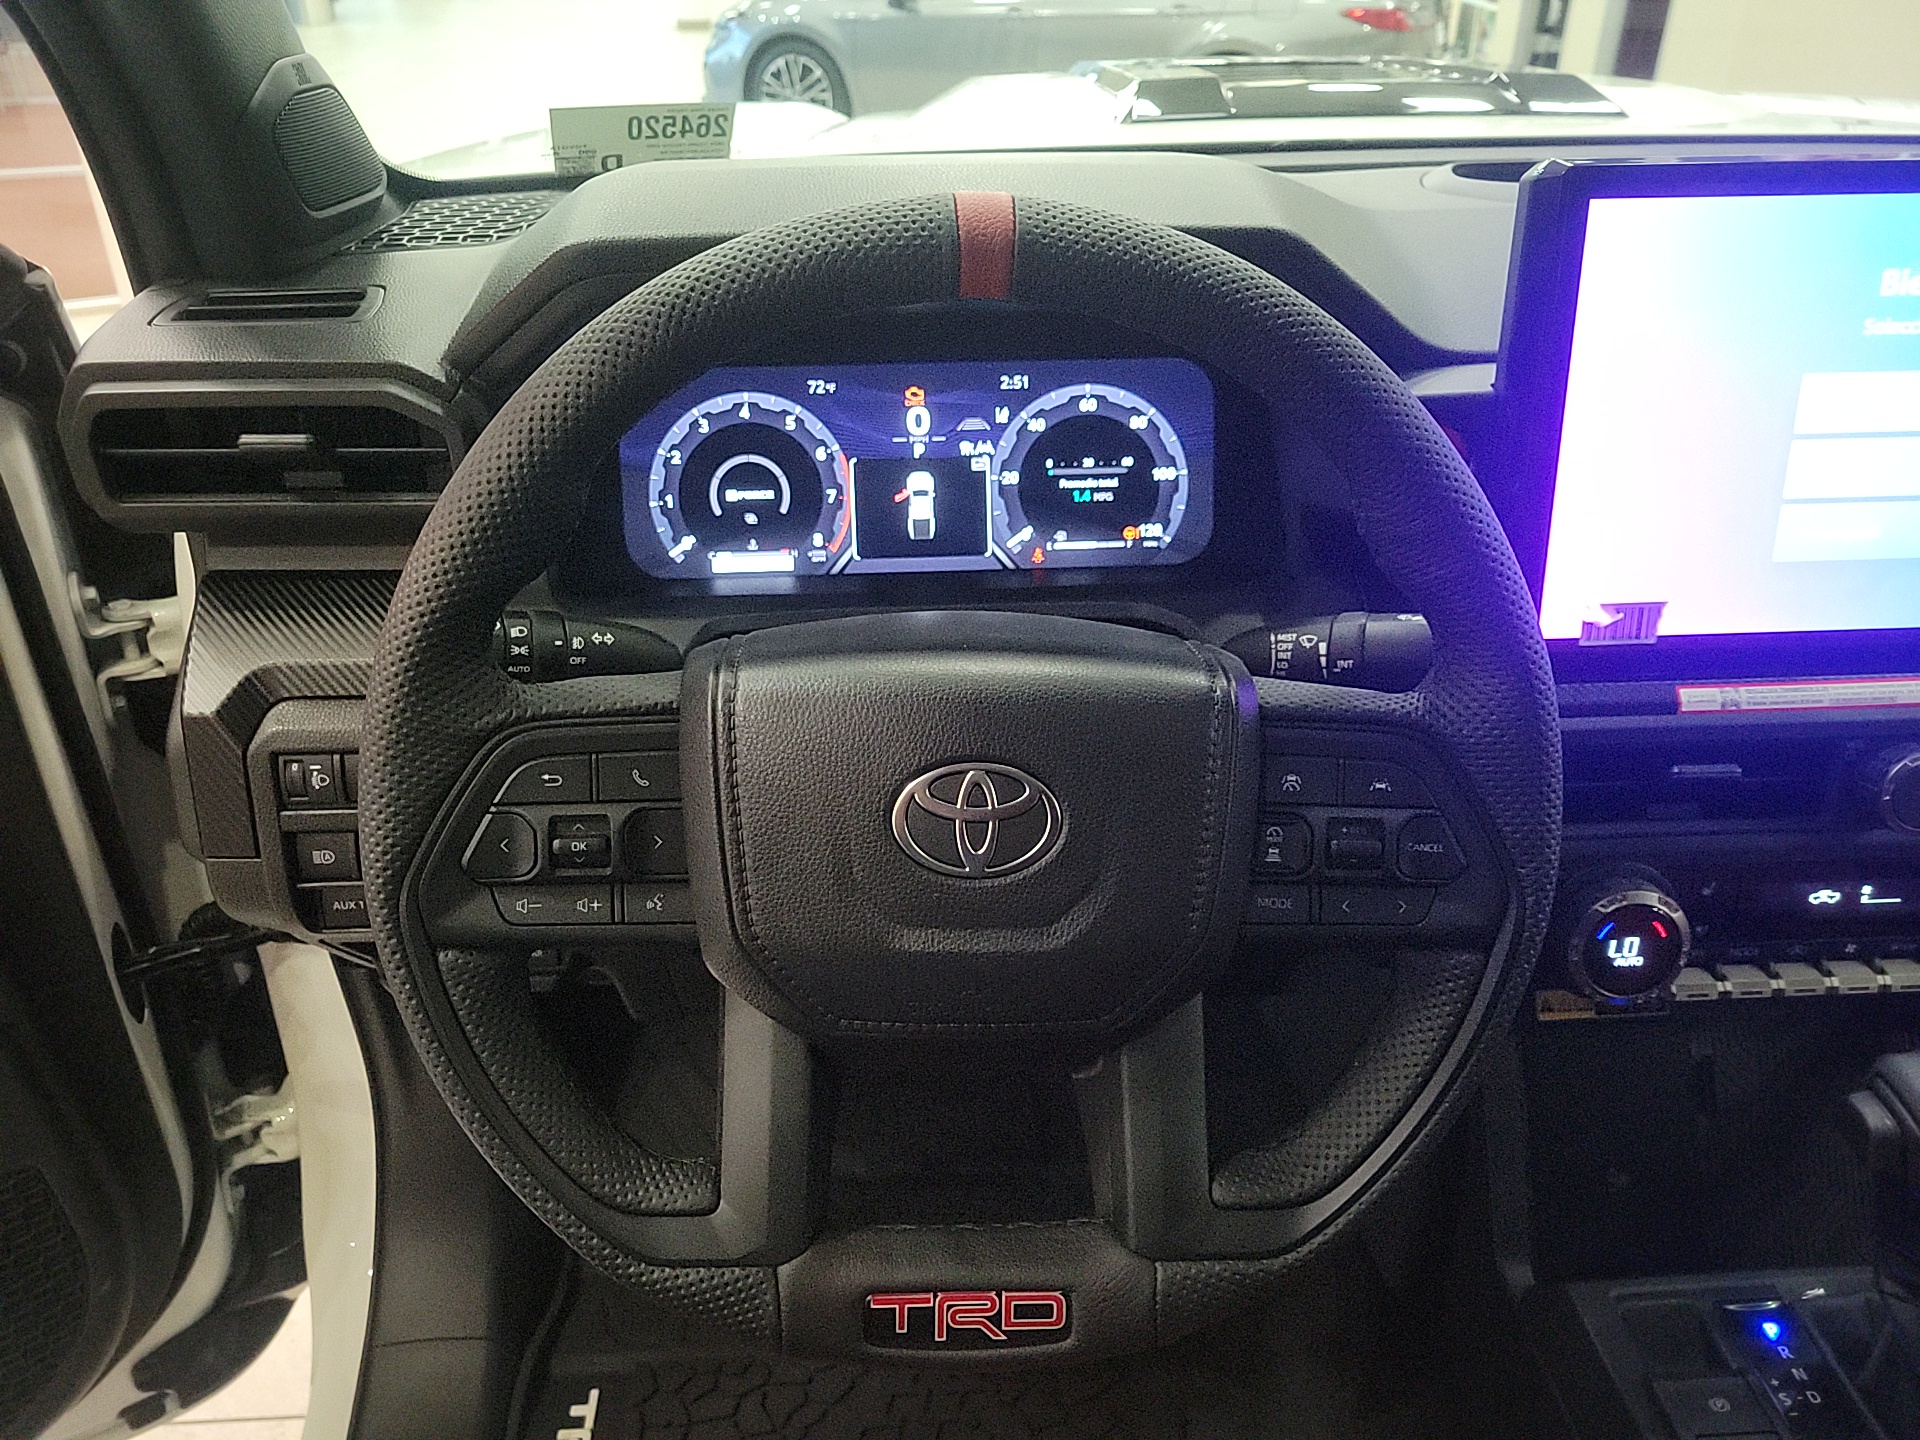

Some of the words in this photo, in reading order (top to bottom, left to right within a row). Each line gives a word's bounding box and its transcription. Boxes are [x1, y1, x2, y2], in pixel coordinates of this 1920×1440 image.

[1000, 375, 1029, 390] 2:51
[738, 404, 750, 420] 4
[1078, 398, 1098, 412] 60
[699, 418, 710, 434] 3
[785, 416, 797, 431] 5
[906, 406, 931, 436] 0
[1027, 418, 1046, 432] 40
[1129, 415, 1149, 430] 80
[670, 450, 682, 465] 2
[815, 447, 828, 462] 6
[913, 442, 925, 459] P
[1002, 471, 1020, 485] 20
[1152, 467, 1176, 481] 100
[665, 494, 674, 509] 1
[826, 489, 838, 504] 7
[1072, 490, 1091, 502] 1.4
[1093, 491, 1114, 502] MPG
[812, 532, 825, 548] 8
[1276, 633, 1297, 641] MIST
[1276, 643, 1294, 651] OFF
[569, 656, 587, 665] OFF
[507, 665, 531, 673] AUTO
[571, 842, 588, 852] OK
[1407, 843, 1444, 853] CANCEL
[333, 901, 357, 910] AUX
[1257, 898, 1294, 909] MODE
[870, 1290, 1067, 1341] TRD
[1777, 1346, 1795, 1359] R
[1791, 1368, 1808, 1381] N
[1778, 1393, 1793, 1406] S
[1806, 1391, 1822, 1404] D
